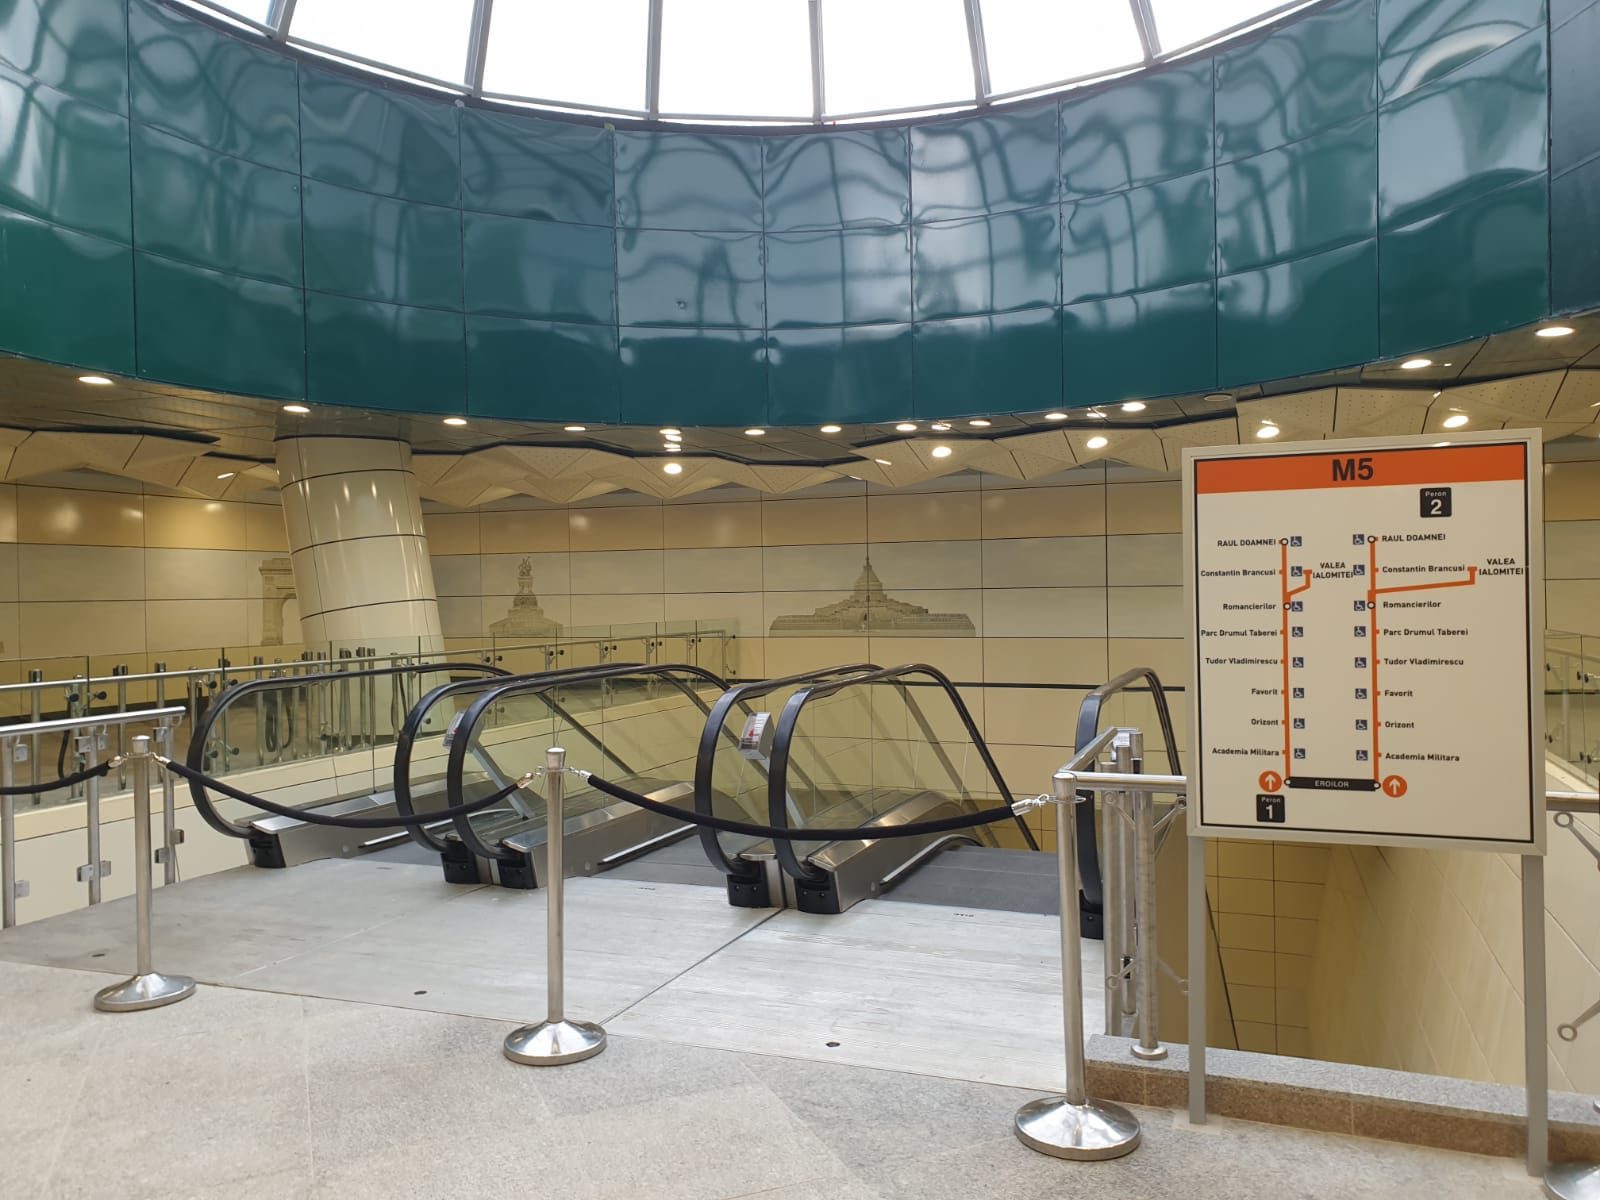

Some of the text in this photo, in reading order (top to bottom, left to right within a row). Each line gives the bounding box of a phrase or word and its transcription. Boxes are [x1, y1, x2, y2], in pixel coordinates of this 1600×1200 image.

[1332, 458, 1374, 482] M5
[1430, 499, 1442, 515] 2
[1200, 568, 1276, 577] Constantin Brancusi
[1382, 564, 1465, 573] Constantin Brancusi
[1313, 571, 1354, 579] IALOMITEI
[1201, 628, 1277, 637] Parc Drumul Taberei
[1383, 628, 1468, 636] Parc Drumul Taberei
[1206, 657, 1278, 665] Tudor Vladimirescu
[1384, 657, 1464, 665] Tudor Vladimirescu
[1384, 689, 1413, 697] Favorit
[1251, 718, 1279, 726] Orizont
[1385, 720, 1415, 728] Orizont
[1212, 747, 1279, 756] Academia Militara
[1385, 753, 1460, 762] Academia Militara
[1266, 804, 1273, 819] 1
